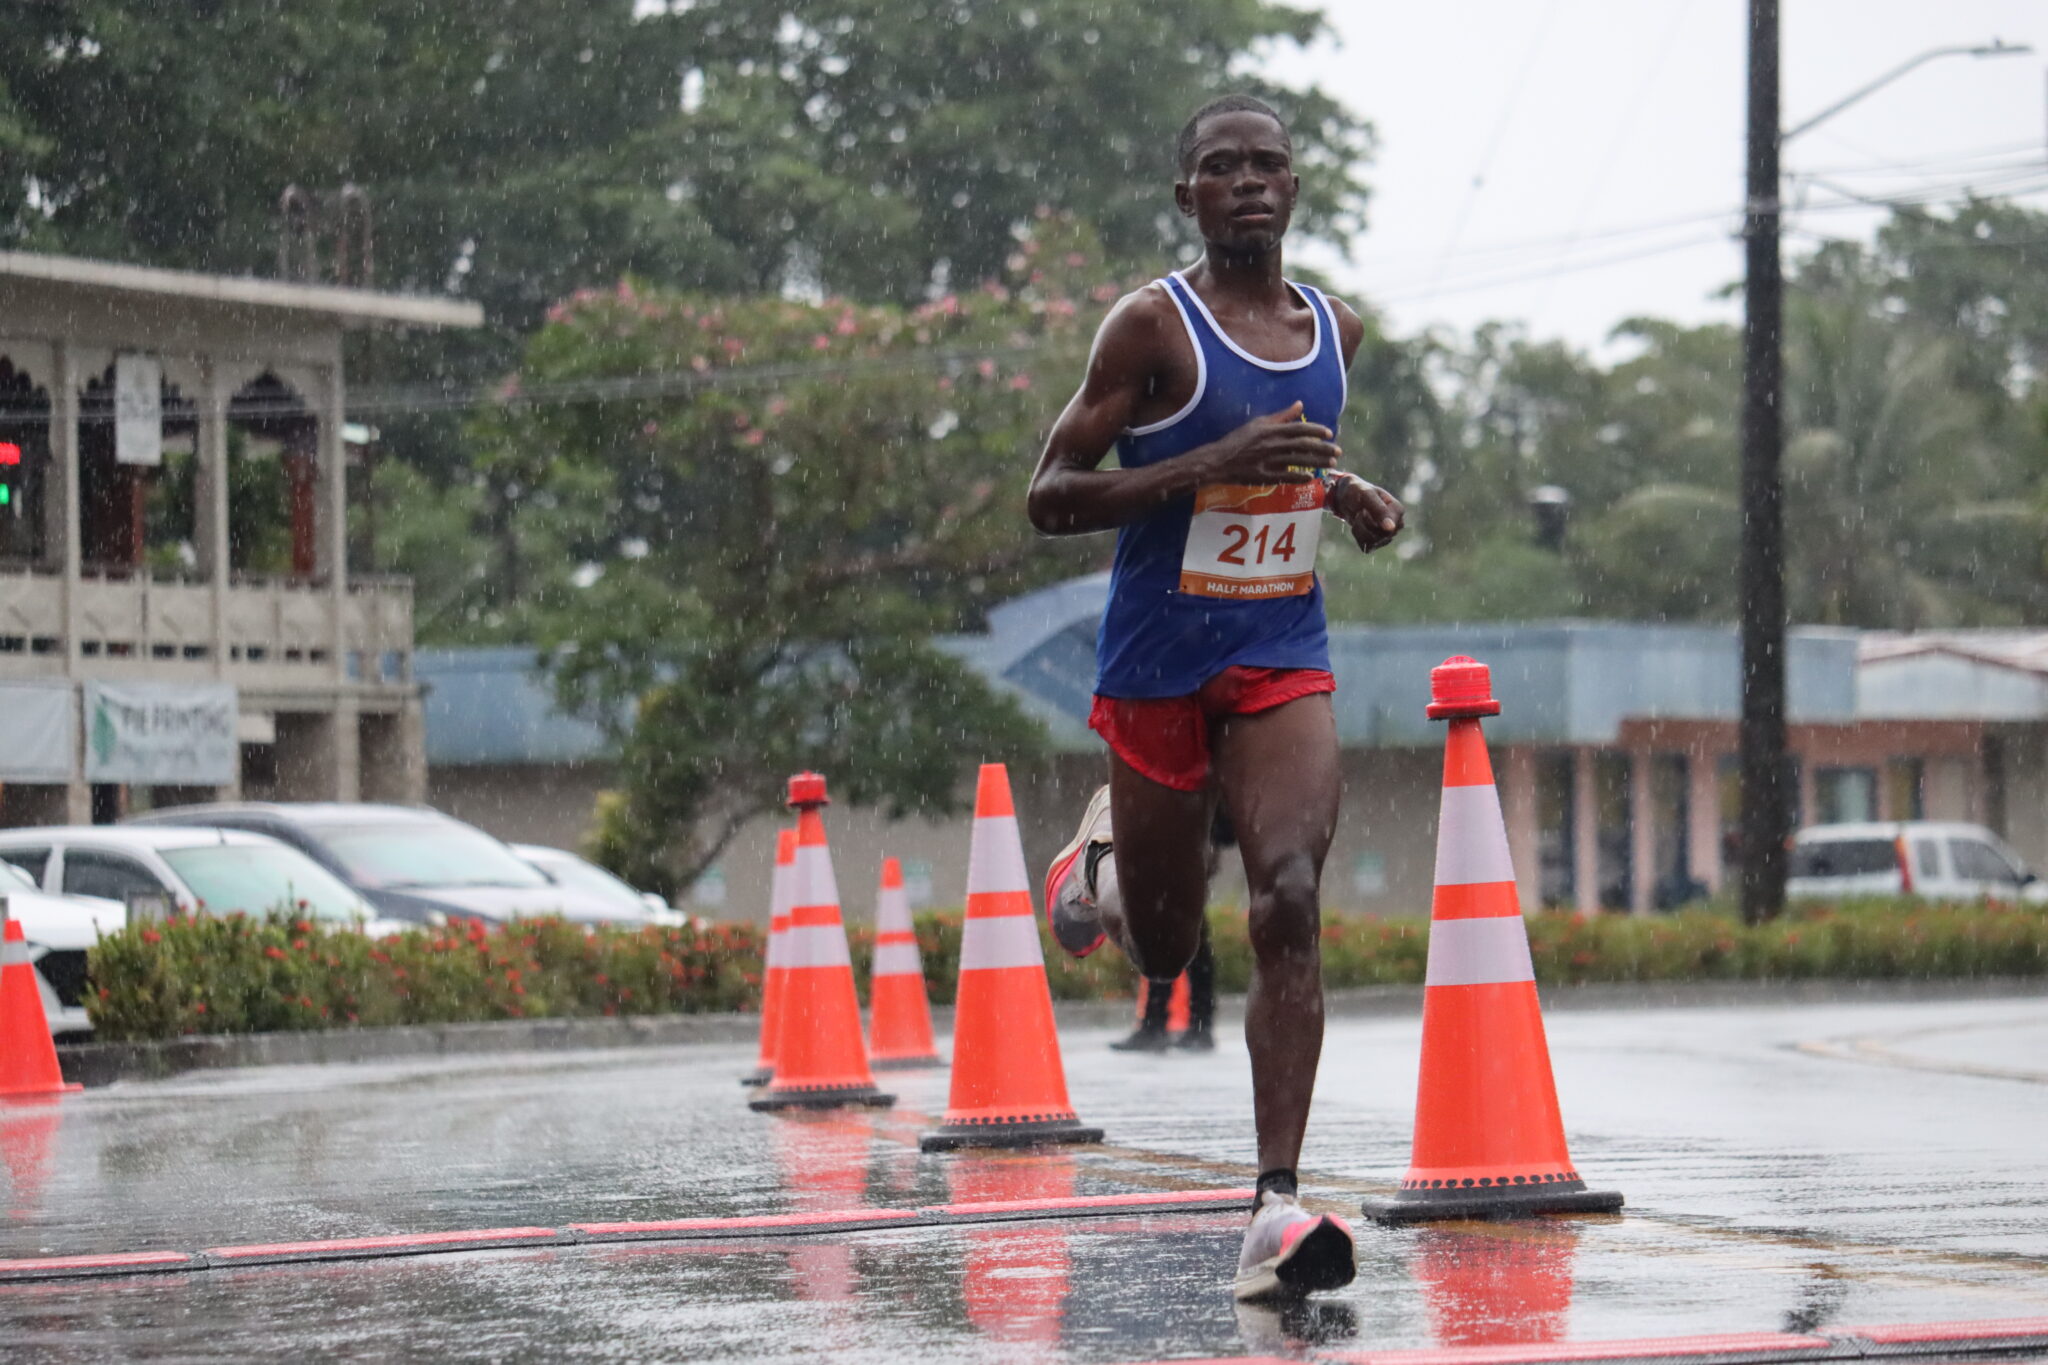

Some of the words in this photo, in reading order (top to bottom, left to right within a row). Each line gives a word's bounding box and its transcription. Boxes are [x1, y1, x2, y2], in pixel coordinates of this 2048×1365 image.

[1218, 523, 1296, 566] 214
[1207, 581, 1237, 594] HALF
[1239, 582, 1295, 595] MARATHON
